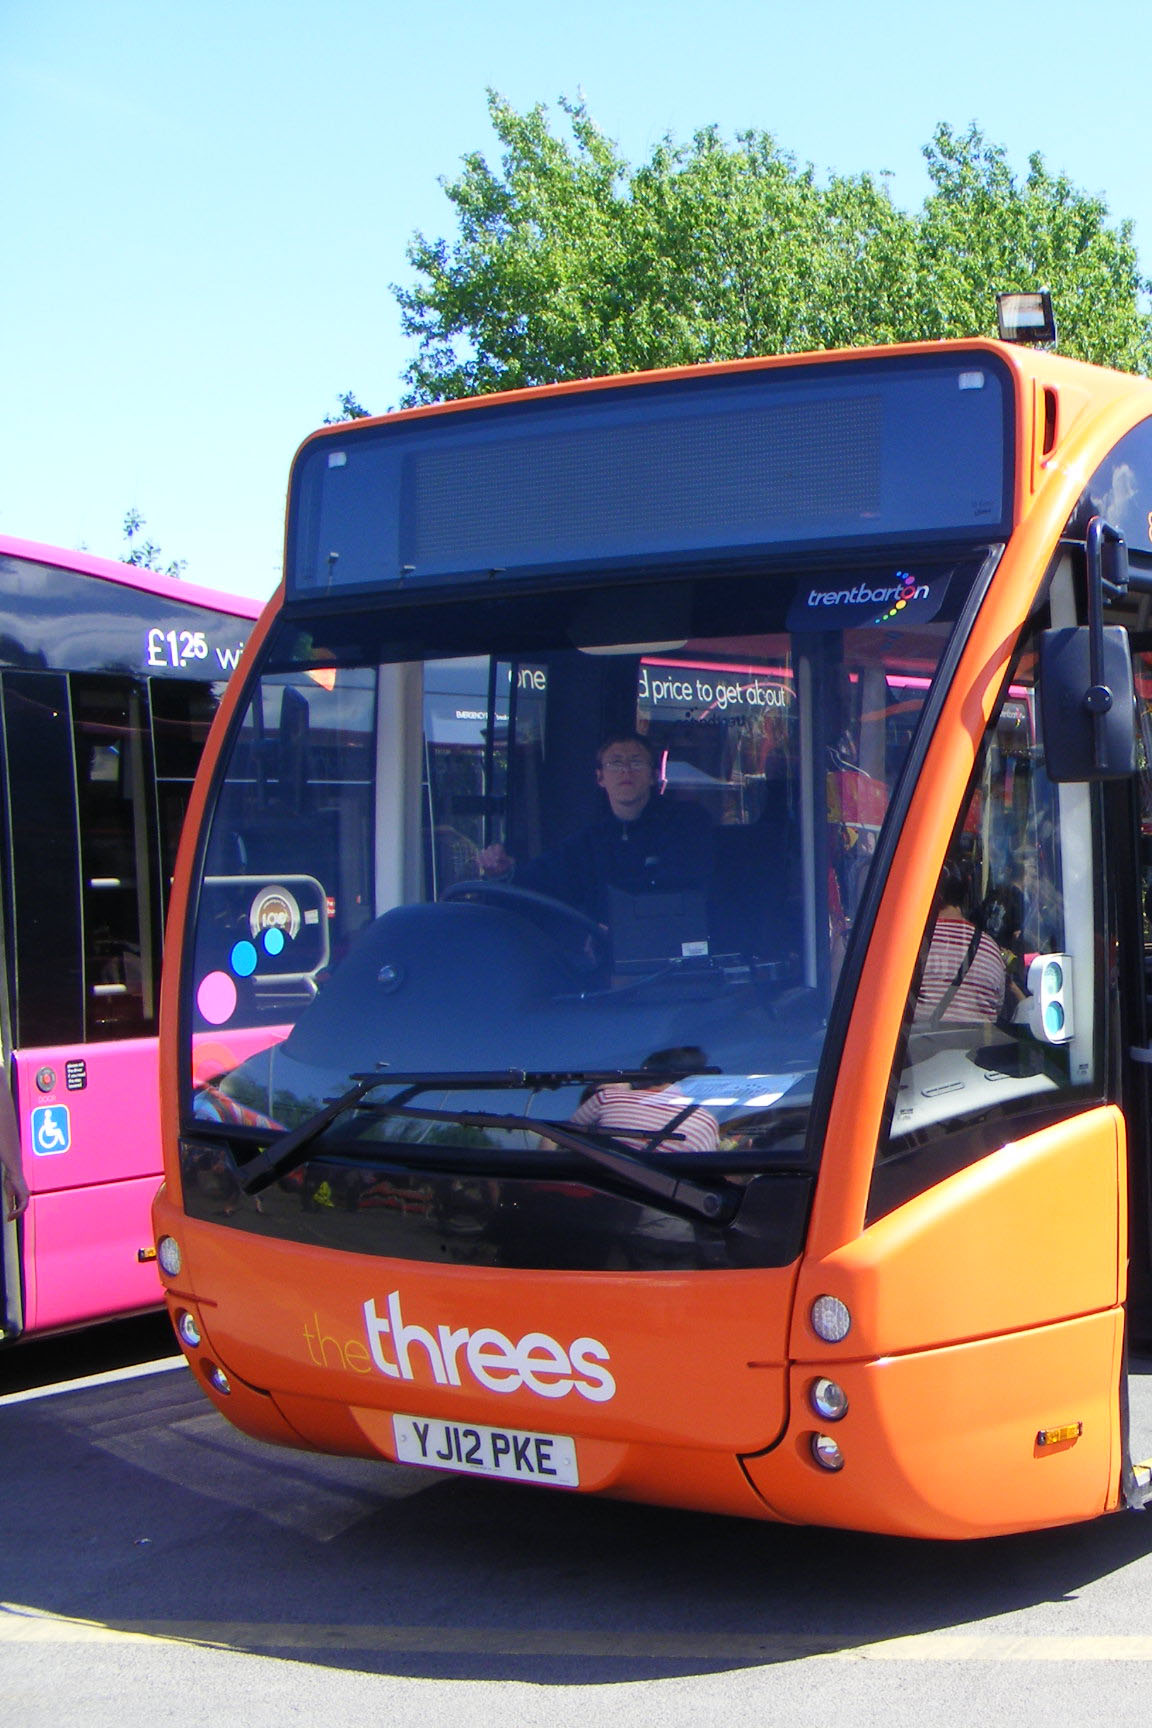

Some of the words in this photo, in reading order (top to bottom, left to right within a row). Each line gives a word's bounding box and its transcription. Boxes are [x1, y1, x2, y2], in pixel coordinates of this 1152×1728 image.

[808, 582, 930, 606] trentbarton
[652, 676, 693, 704] price
[696, 679, 712, 702] to
[716, 682, 744, 709] get
[746, 679, 786, 707] about
[302, 1312, 372, 1374] the
[363, 1290, 617, 1402] threes
[412, 1421, 484, 1466] YJ12
[490, 1432, 558, 1476] PKE
